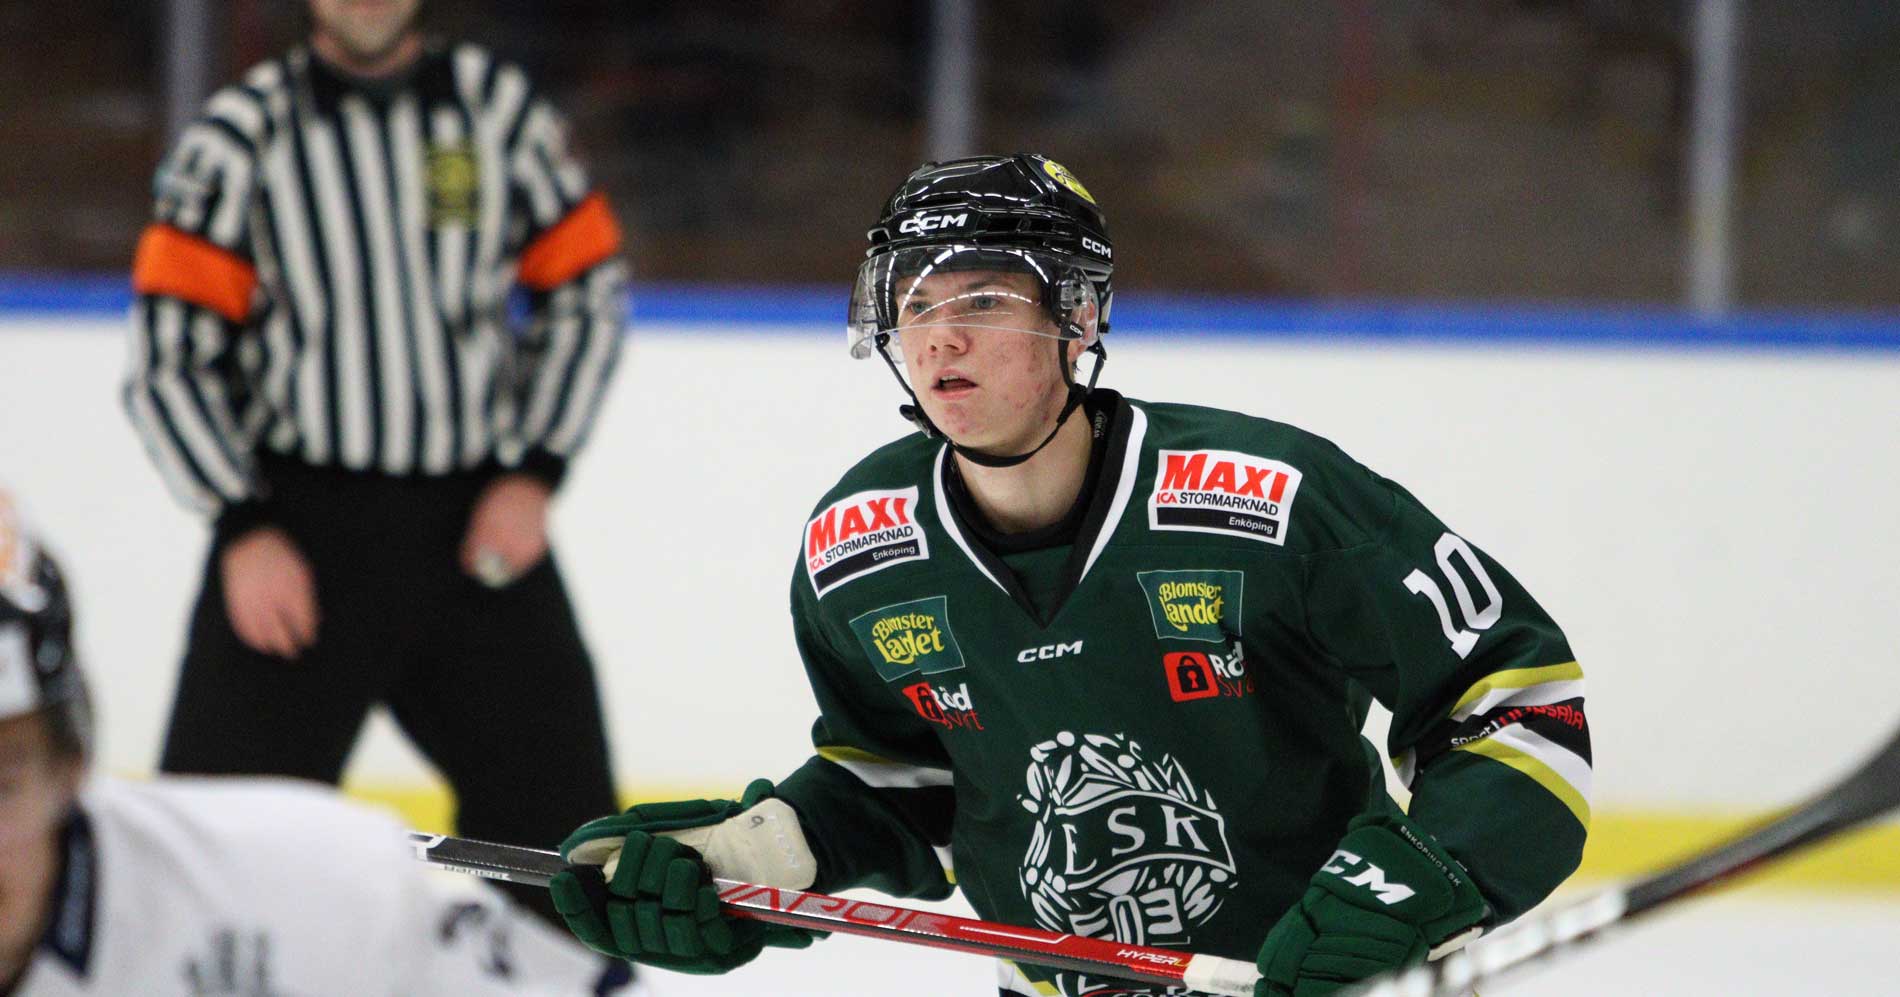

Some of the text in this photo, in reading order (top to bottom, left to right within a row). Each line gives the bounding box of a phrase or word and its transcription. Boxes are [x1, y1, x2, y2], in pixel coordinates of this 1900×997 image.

[899, 213, 969, 233] CCM
[1082, 236, 1112, 259] CCM
[1160, 453, 1289, 503] MAXI
[1156, 491, 1278, 516] ICA STORMARKNAD
[809, 497, 910, 559] MAXI
[1228, 516, 1274, 535] Enköping
[809, 525, 914, 573] ICA STORMARKNAD
[872, 546, 915, 561] Enköping
[1402, 532, 1503, 660] 10
[1017, 640, 1083, 663] CCM
[1062, 805, 1211, 876] ESK
